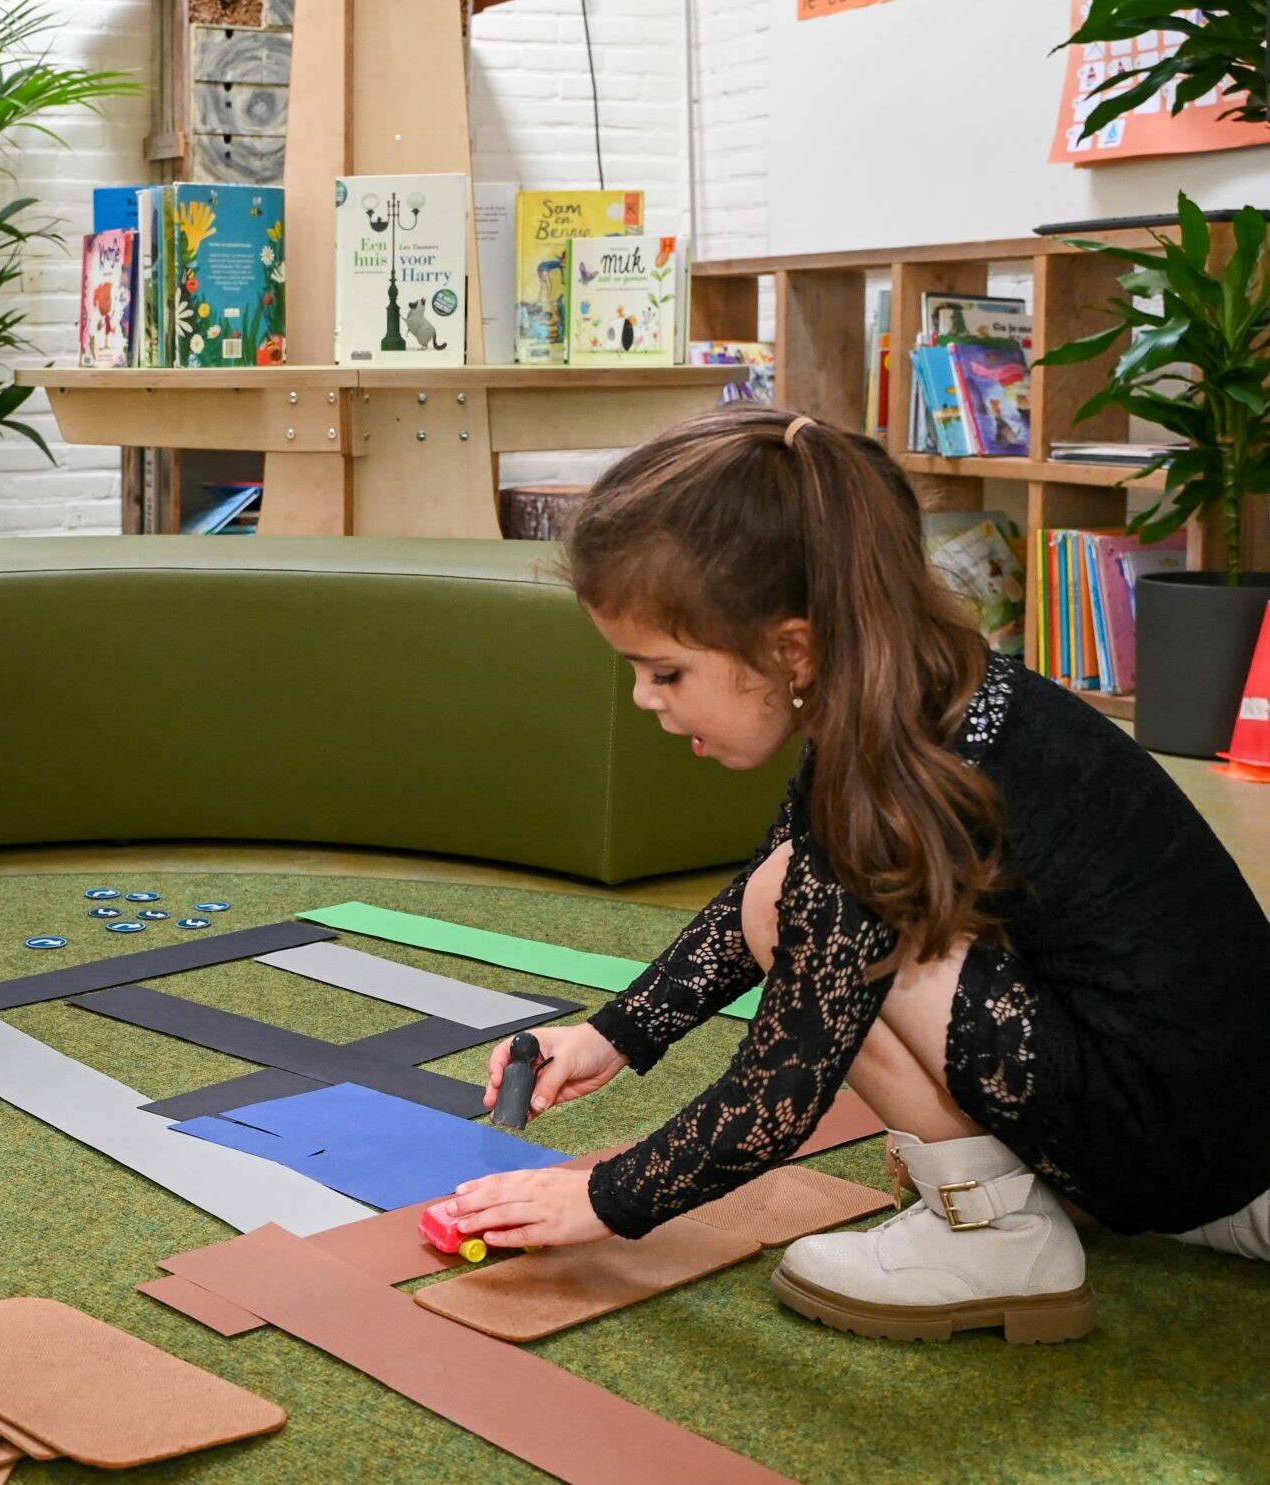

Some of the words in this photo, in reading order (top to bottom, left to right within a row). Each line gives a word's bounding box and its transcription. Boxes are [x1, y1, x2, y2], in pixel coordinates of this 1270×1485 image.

[542, 200, 582, 219] Sam
[626, 203, 636, 216] K
[554, 215, 573, 225] en
[361, 238, 387, 251] Een
[662, 240, 672, 253] H
[354, 251, 387, 267] huis
[399, 255, 436, 266] voor
[600, 246, 646, 275] muk
[402, 268, 452, 286] Harry
